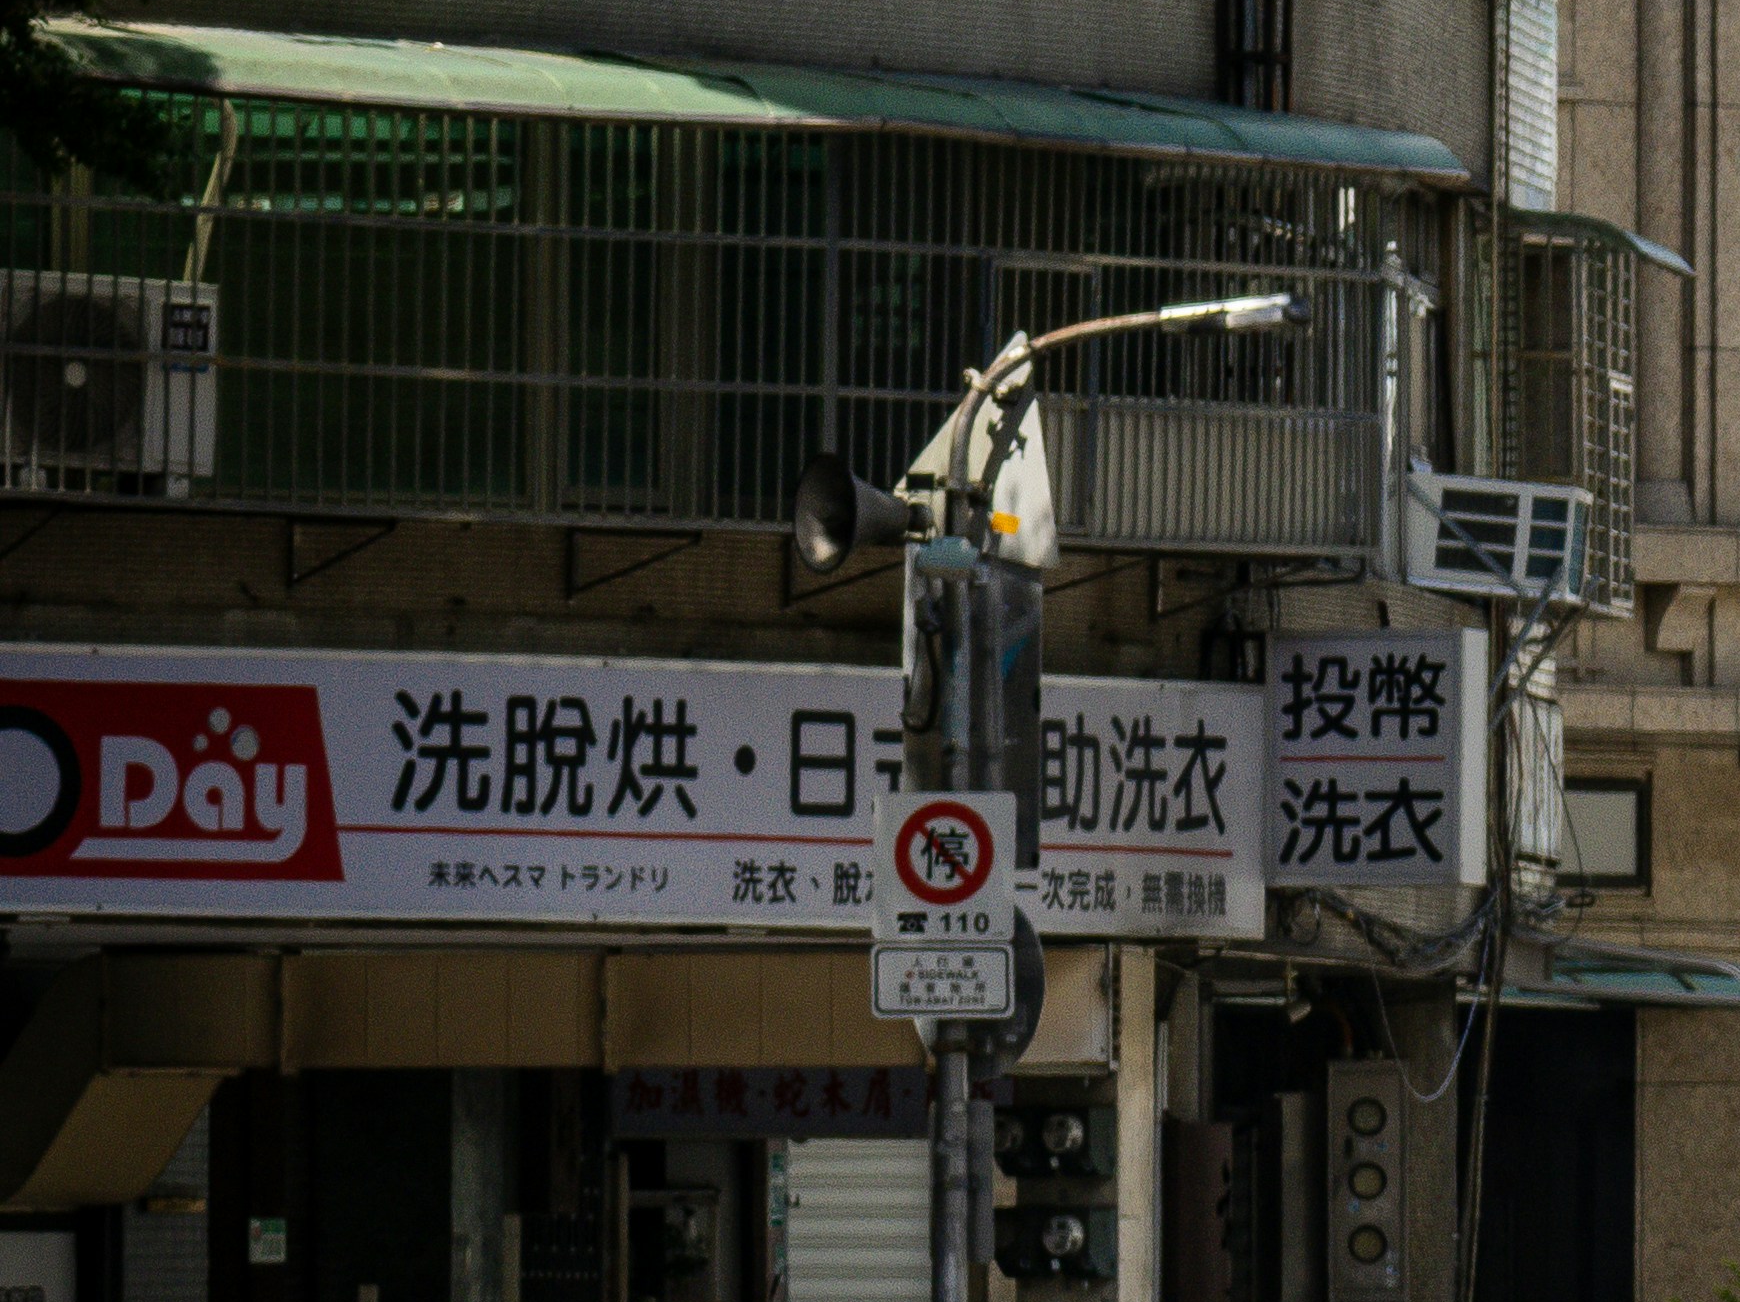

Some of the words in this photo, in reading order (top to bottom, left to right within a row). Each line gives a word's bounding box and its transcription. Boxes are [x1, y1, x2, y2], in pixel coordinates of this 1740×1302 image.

[1279, 651, 1447, 742] 投幣
[920, 826, 971, 881] 停
[1278, 776, 1445, 866] 洗衣
[939, 911, 990, 934] 110
